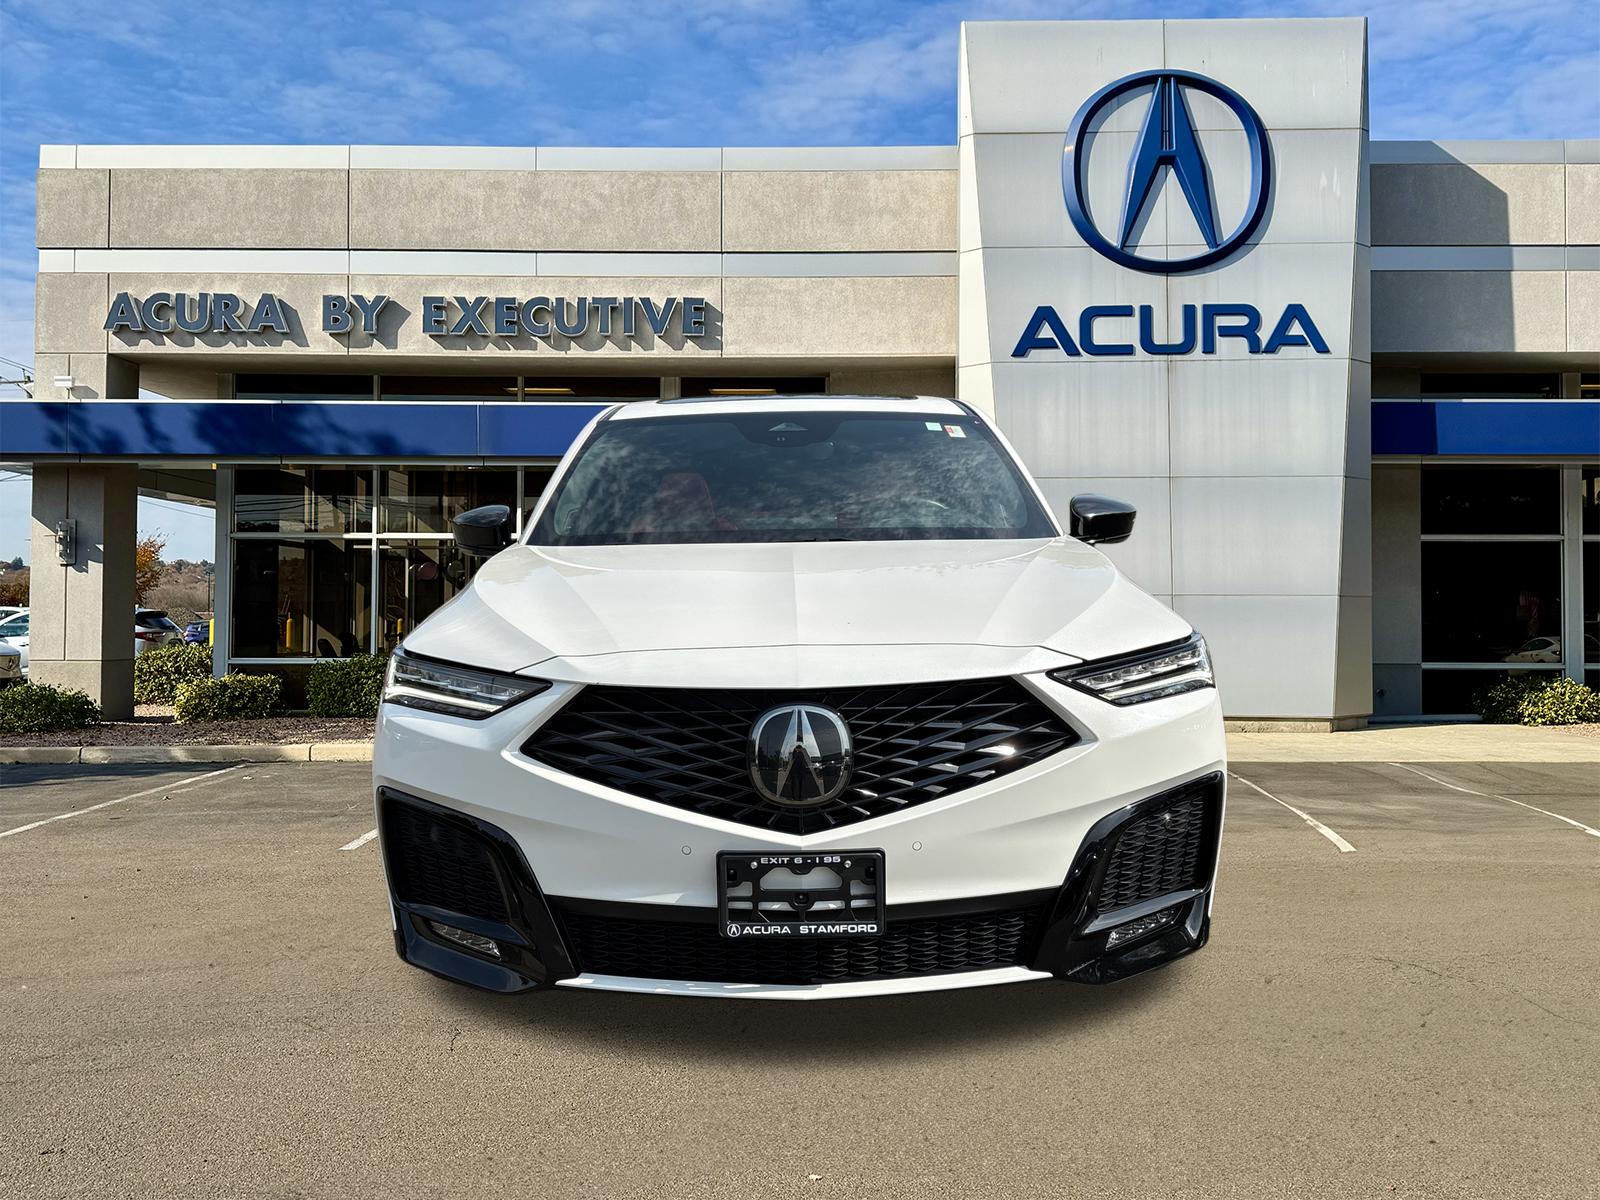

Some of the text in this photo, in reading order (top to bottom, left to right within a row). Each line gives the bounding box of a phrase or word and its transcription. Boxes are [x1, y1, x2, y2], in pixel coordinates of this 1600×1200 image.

[104, 291, 707, 338] ACURA BY EXECUTIVE
[1010, 303, 1332, 358] ACURA
[742, 924, 877, 935] ACURA STAMFORD
